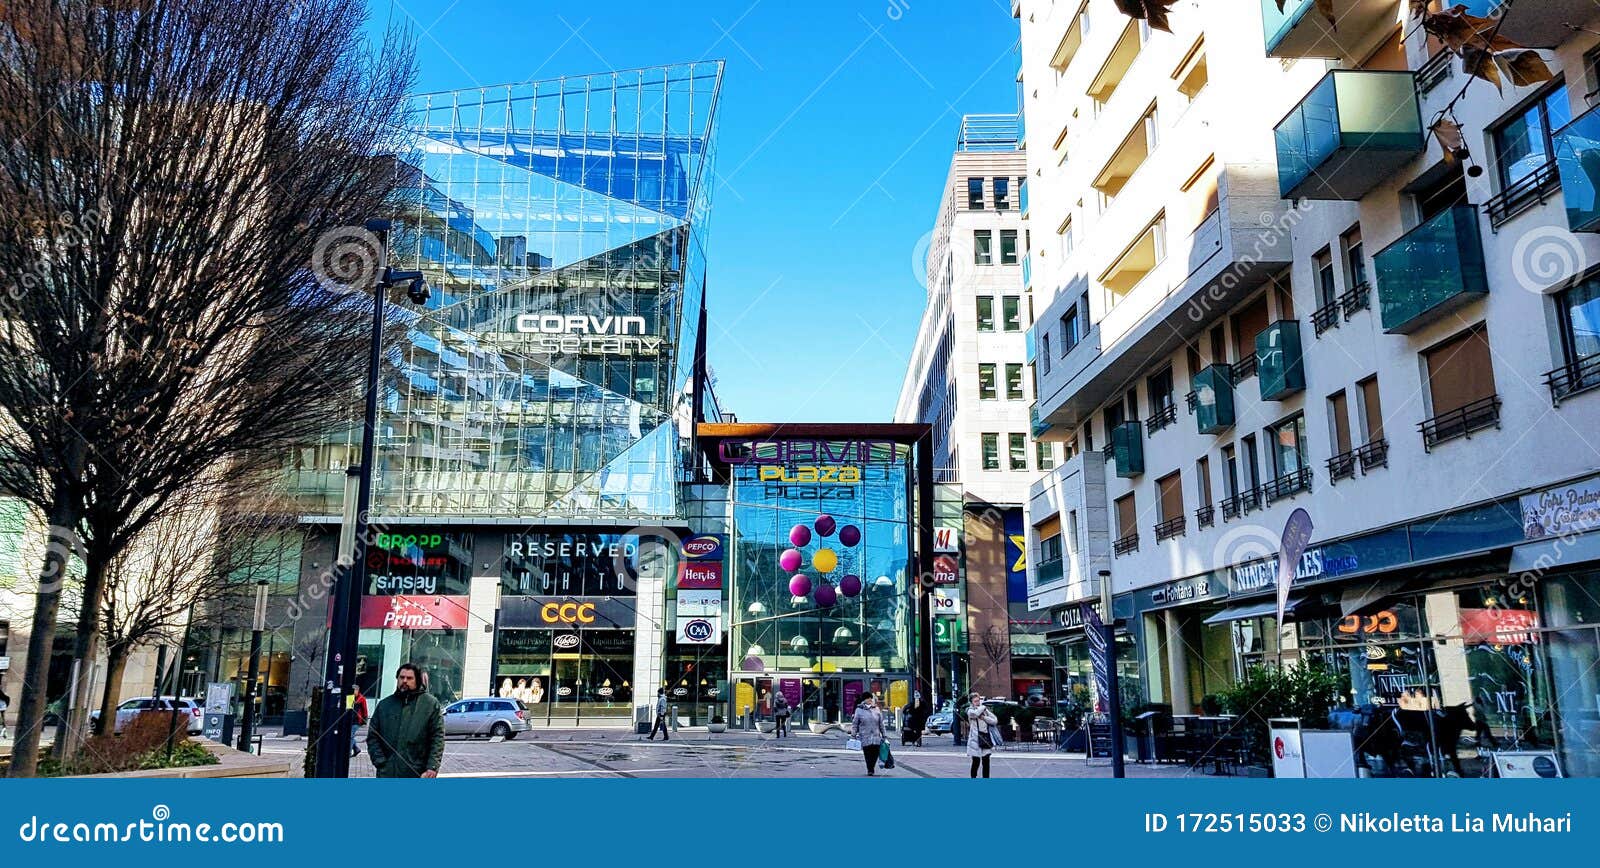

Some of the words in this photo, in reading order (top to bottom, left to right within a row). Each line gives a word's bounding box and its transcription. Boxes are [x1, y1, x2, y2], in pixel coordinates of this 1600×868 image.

[517, 314, 646, 335] CORVIN
[719, 439, 896, 463] CORVIN
[511, 542, 635, 557] RESERVED
[377, 572, 436, 594] sinsay
[520, 572, 624, 590] MOHTO
[685, 569, 716, 582] Hervis
[1236, 564, 1266, 591] NINE
[383, 611, 433, 626] Prima
[541, 602, 595, 623] CCC
[1060, 608, 1081, 627] COSTA
[689, 625, 708, 636] C&A
